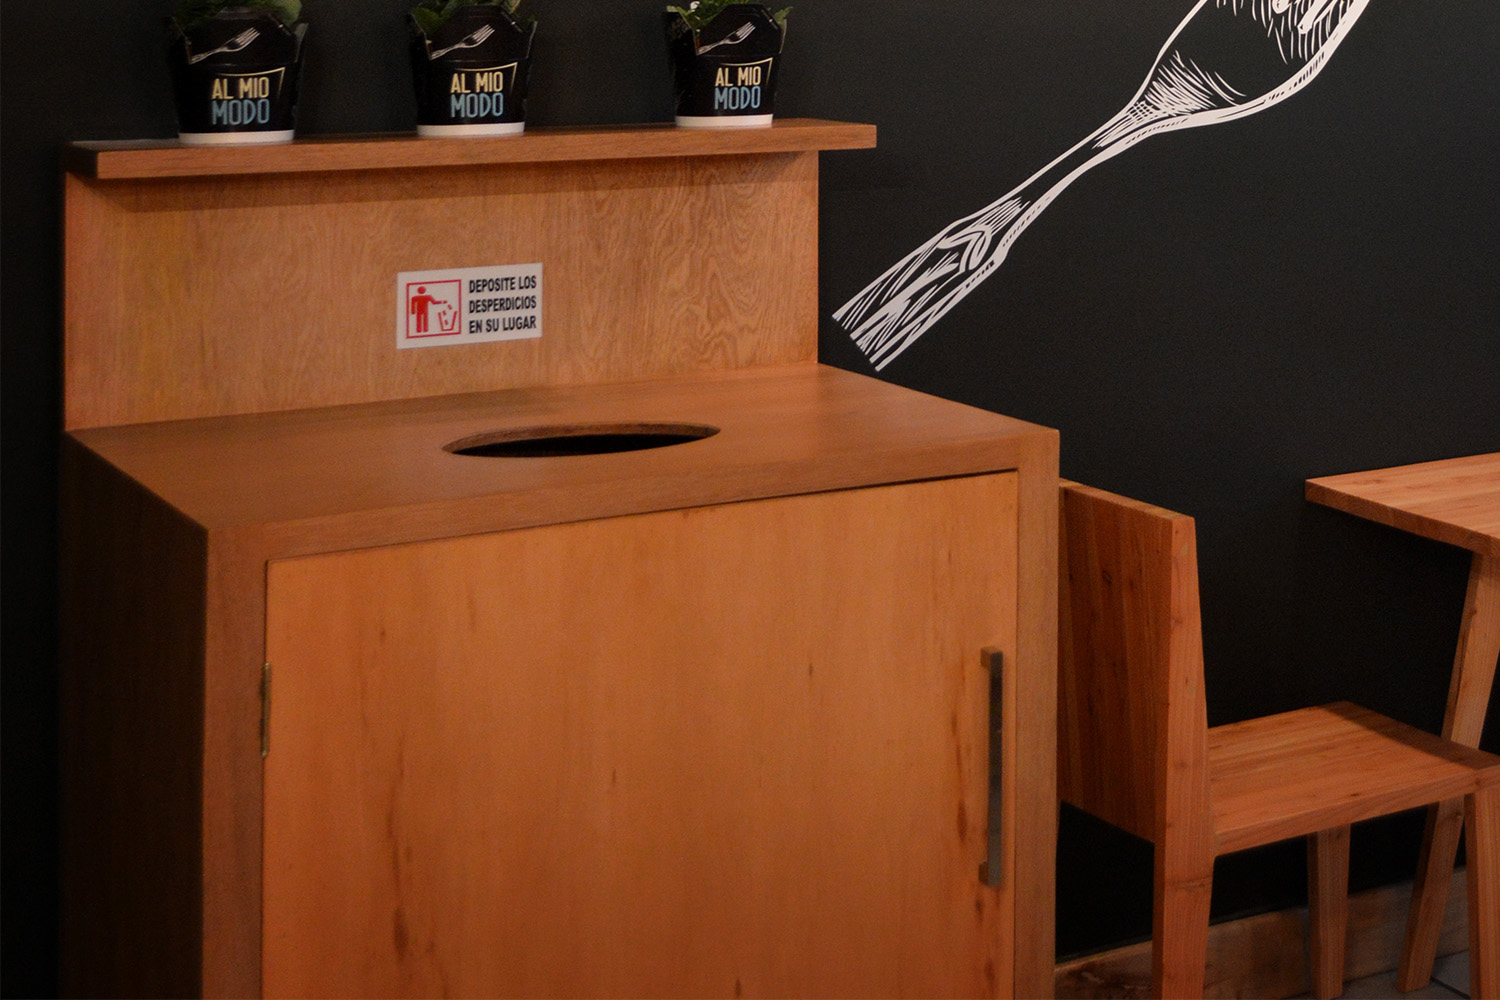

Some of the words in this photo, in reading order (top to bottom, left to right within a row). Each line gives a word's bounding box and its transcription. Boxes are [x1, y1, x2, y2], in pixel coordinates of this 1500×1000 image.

[450, 73, 471, 93] AL
[475, 71, 504, 93] MIO
[715, 67, 734, 87] AL
[737, 66, 762, 87] MIO
[211, 78, 234, 100] AL
[239, 76, 270, 99] MIO
[714, 85, 761, 110] MODO
[212, 99, 270, 125] MODO
[450, 92, 504, 118] MODO
[469, 277, 516, 294] DEPOSITE
[518, 275, 537, 290] LOS
[469, 295, 537, 314] DESPERDICIOS
[469, 320, 483, 334] EN
[485, 318, 499, 333] SU
[502, 315, 537, 332] LUGAR
